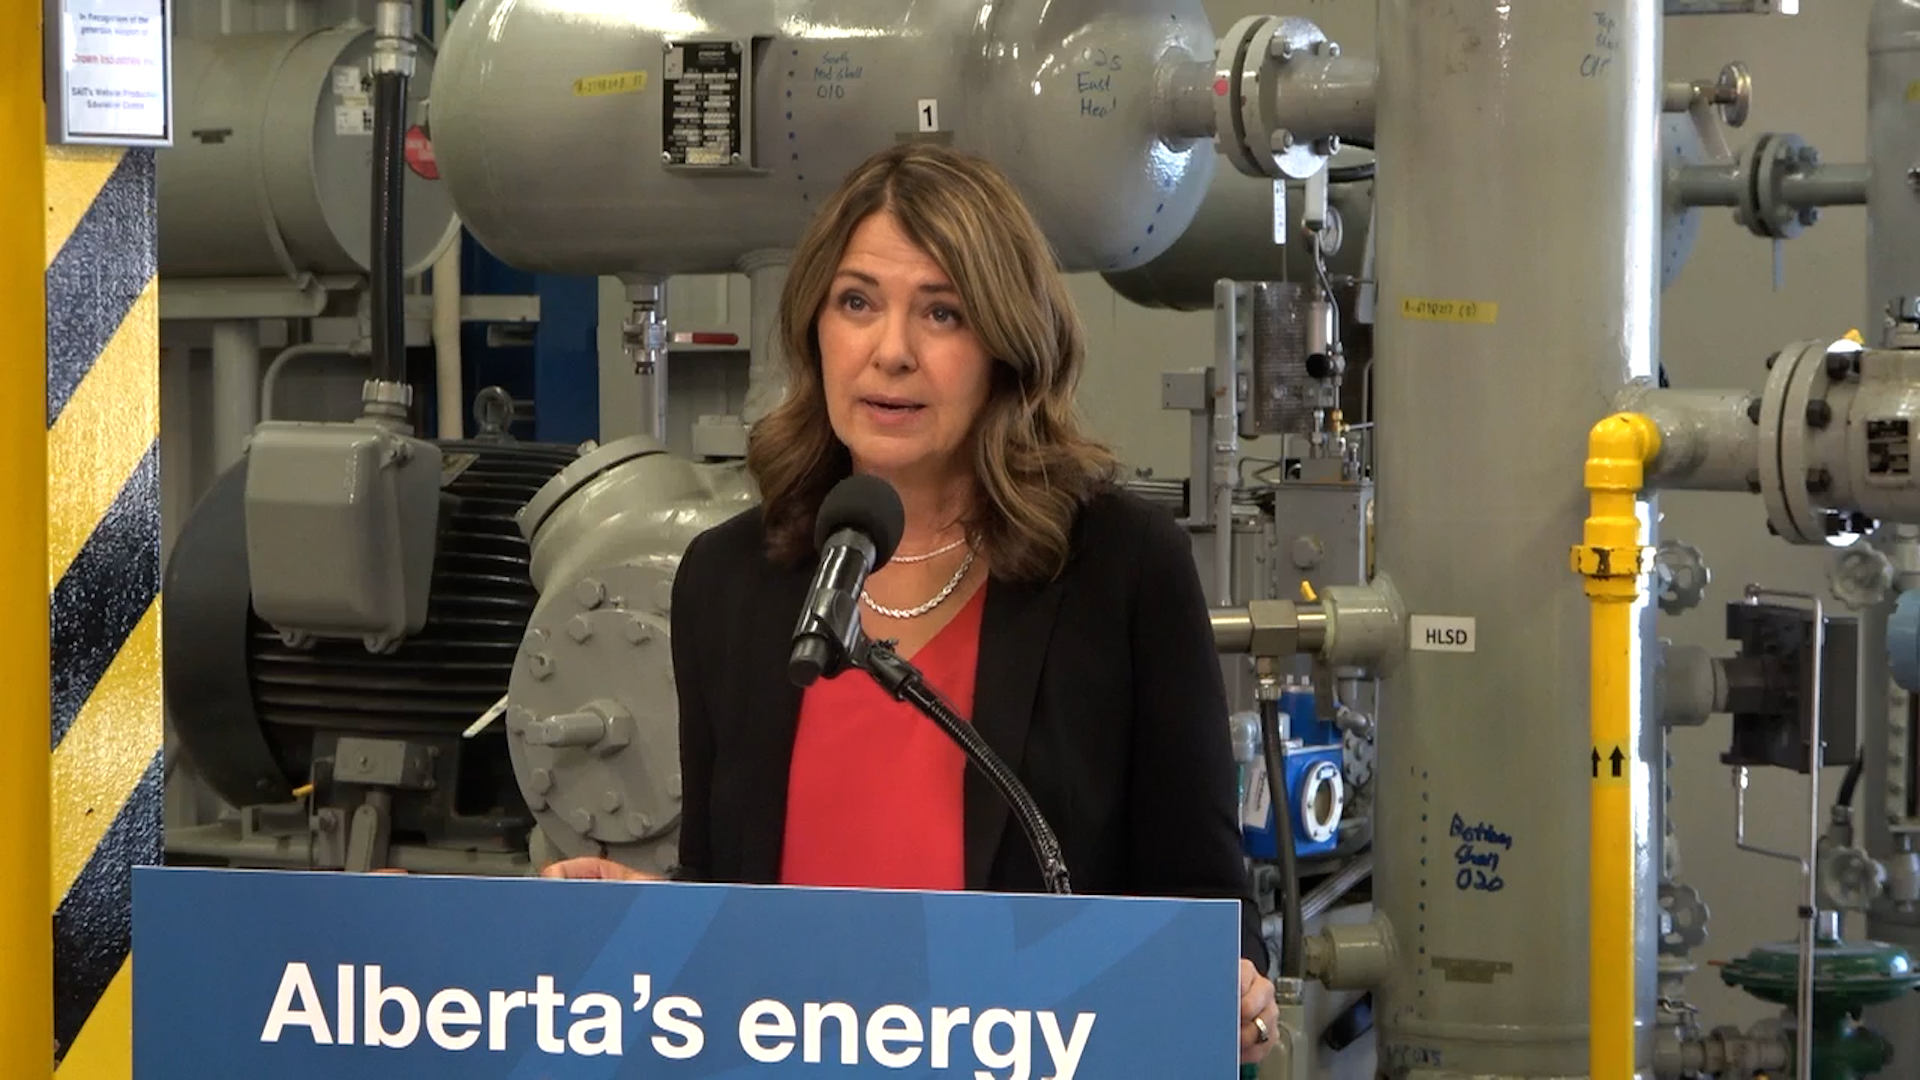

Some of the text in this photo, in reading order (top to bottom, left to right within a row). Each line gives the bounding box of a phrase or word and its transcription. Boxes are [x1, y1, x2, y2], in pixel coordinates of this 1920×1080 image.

[923, 105, 932, 127] 1
[1426, 629, 1468, 645] HLSD
[260, 962, 1097, 1080] Alberta’s energy
